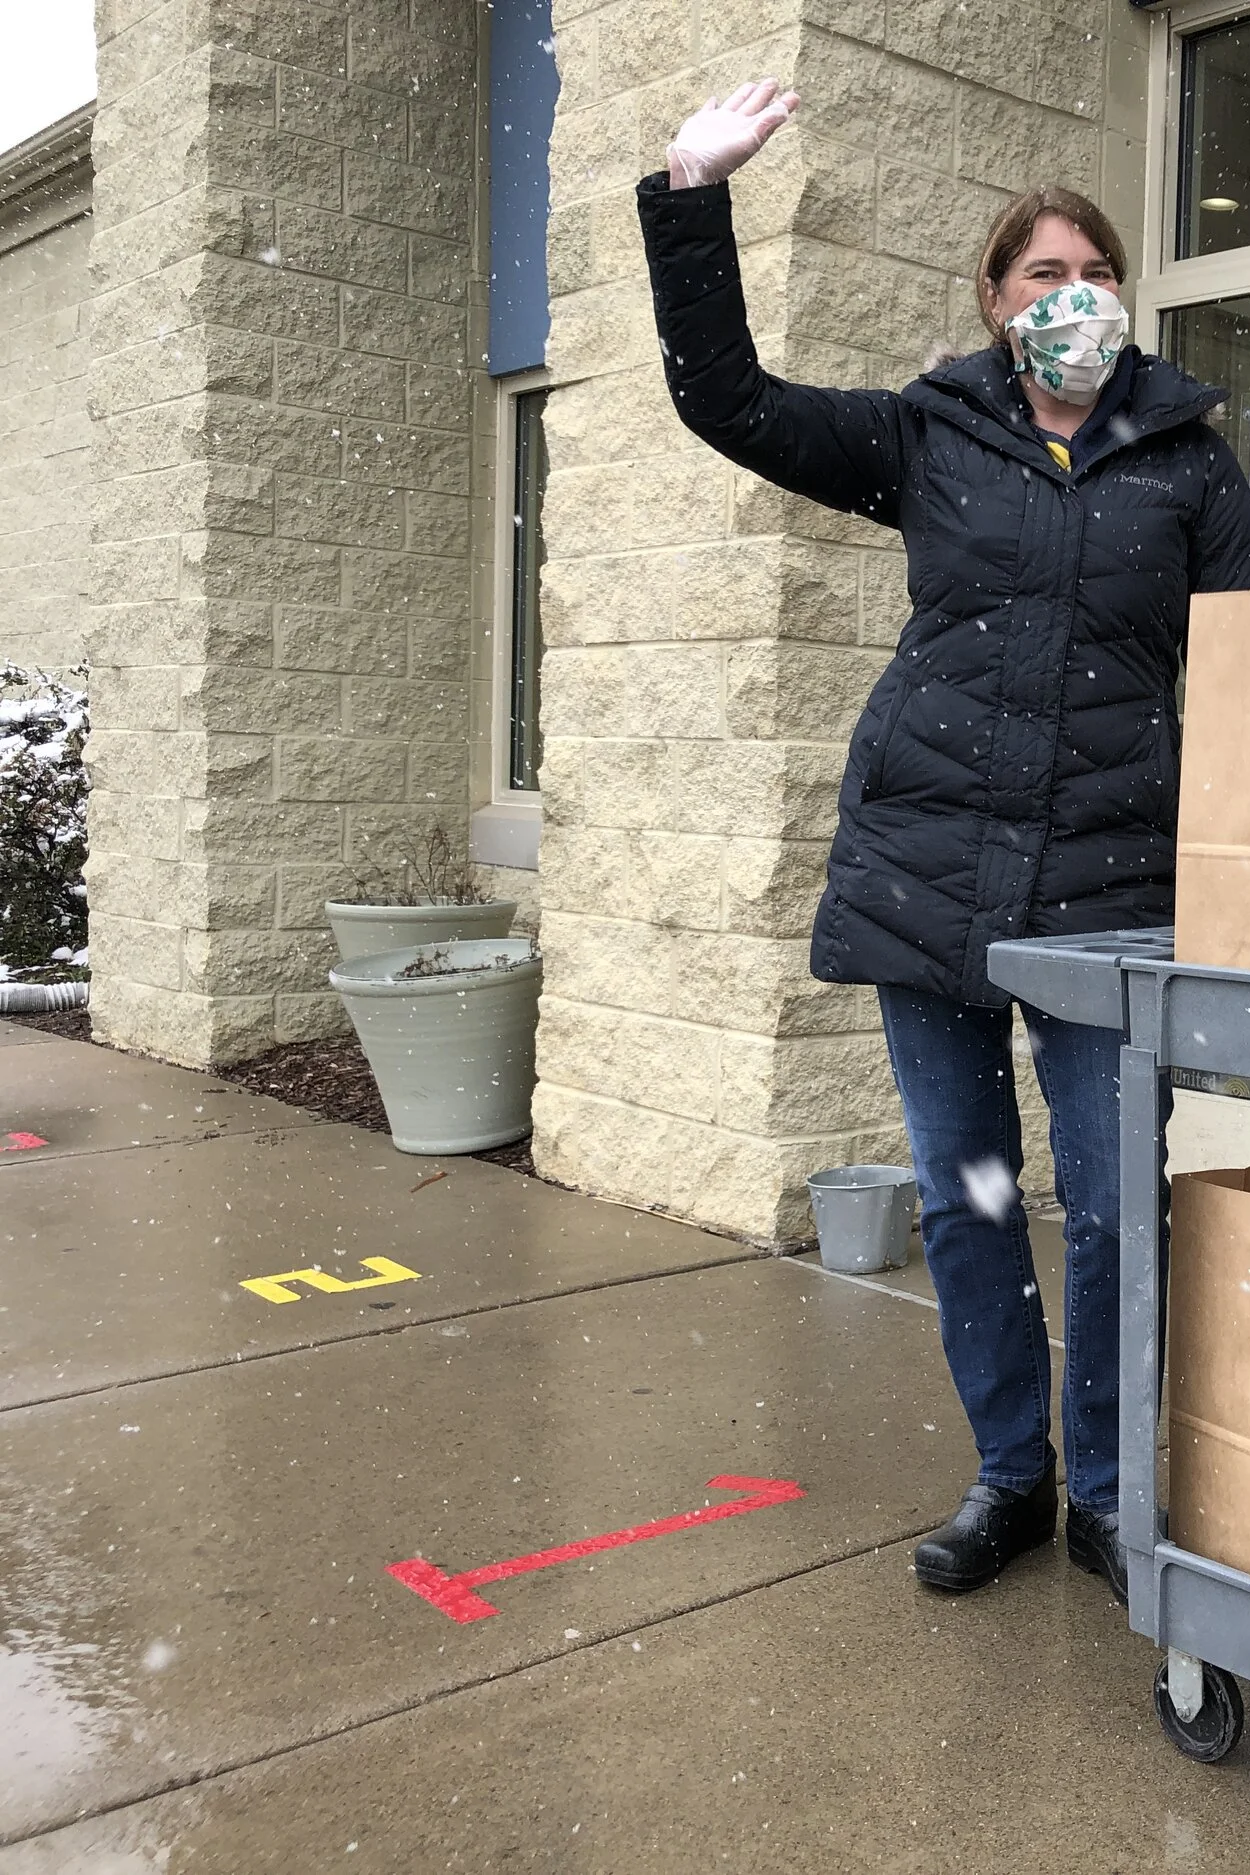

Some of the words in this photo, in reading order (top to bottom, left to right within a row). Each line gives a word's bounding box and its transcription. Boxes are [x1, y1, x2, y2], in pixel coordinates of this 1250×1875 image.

[1120, 474, 1174, 493] Marmot
[1173, 1068, 1216, 1091] United
[239, 1256, 422, 1304] 2
[385, 1474, 807, 1624] 1
